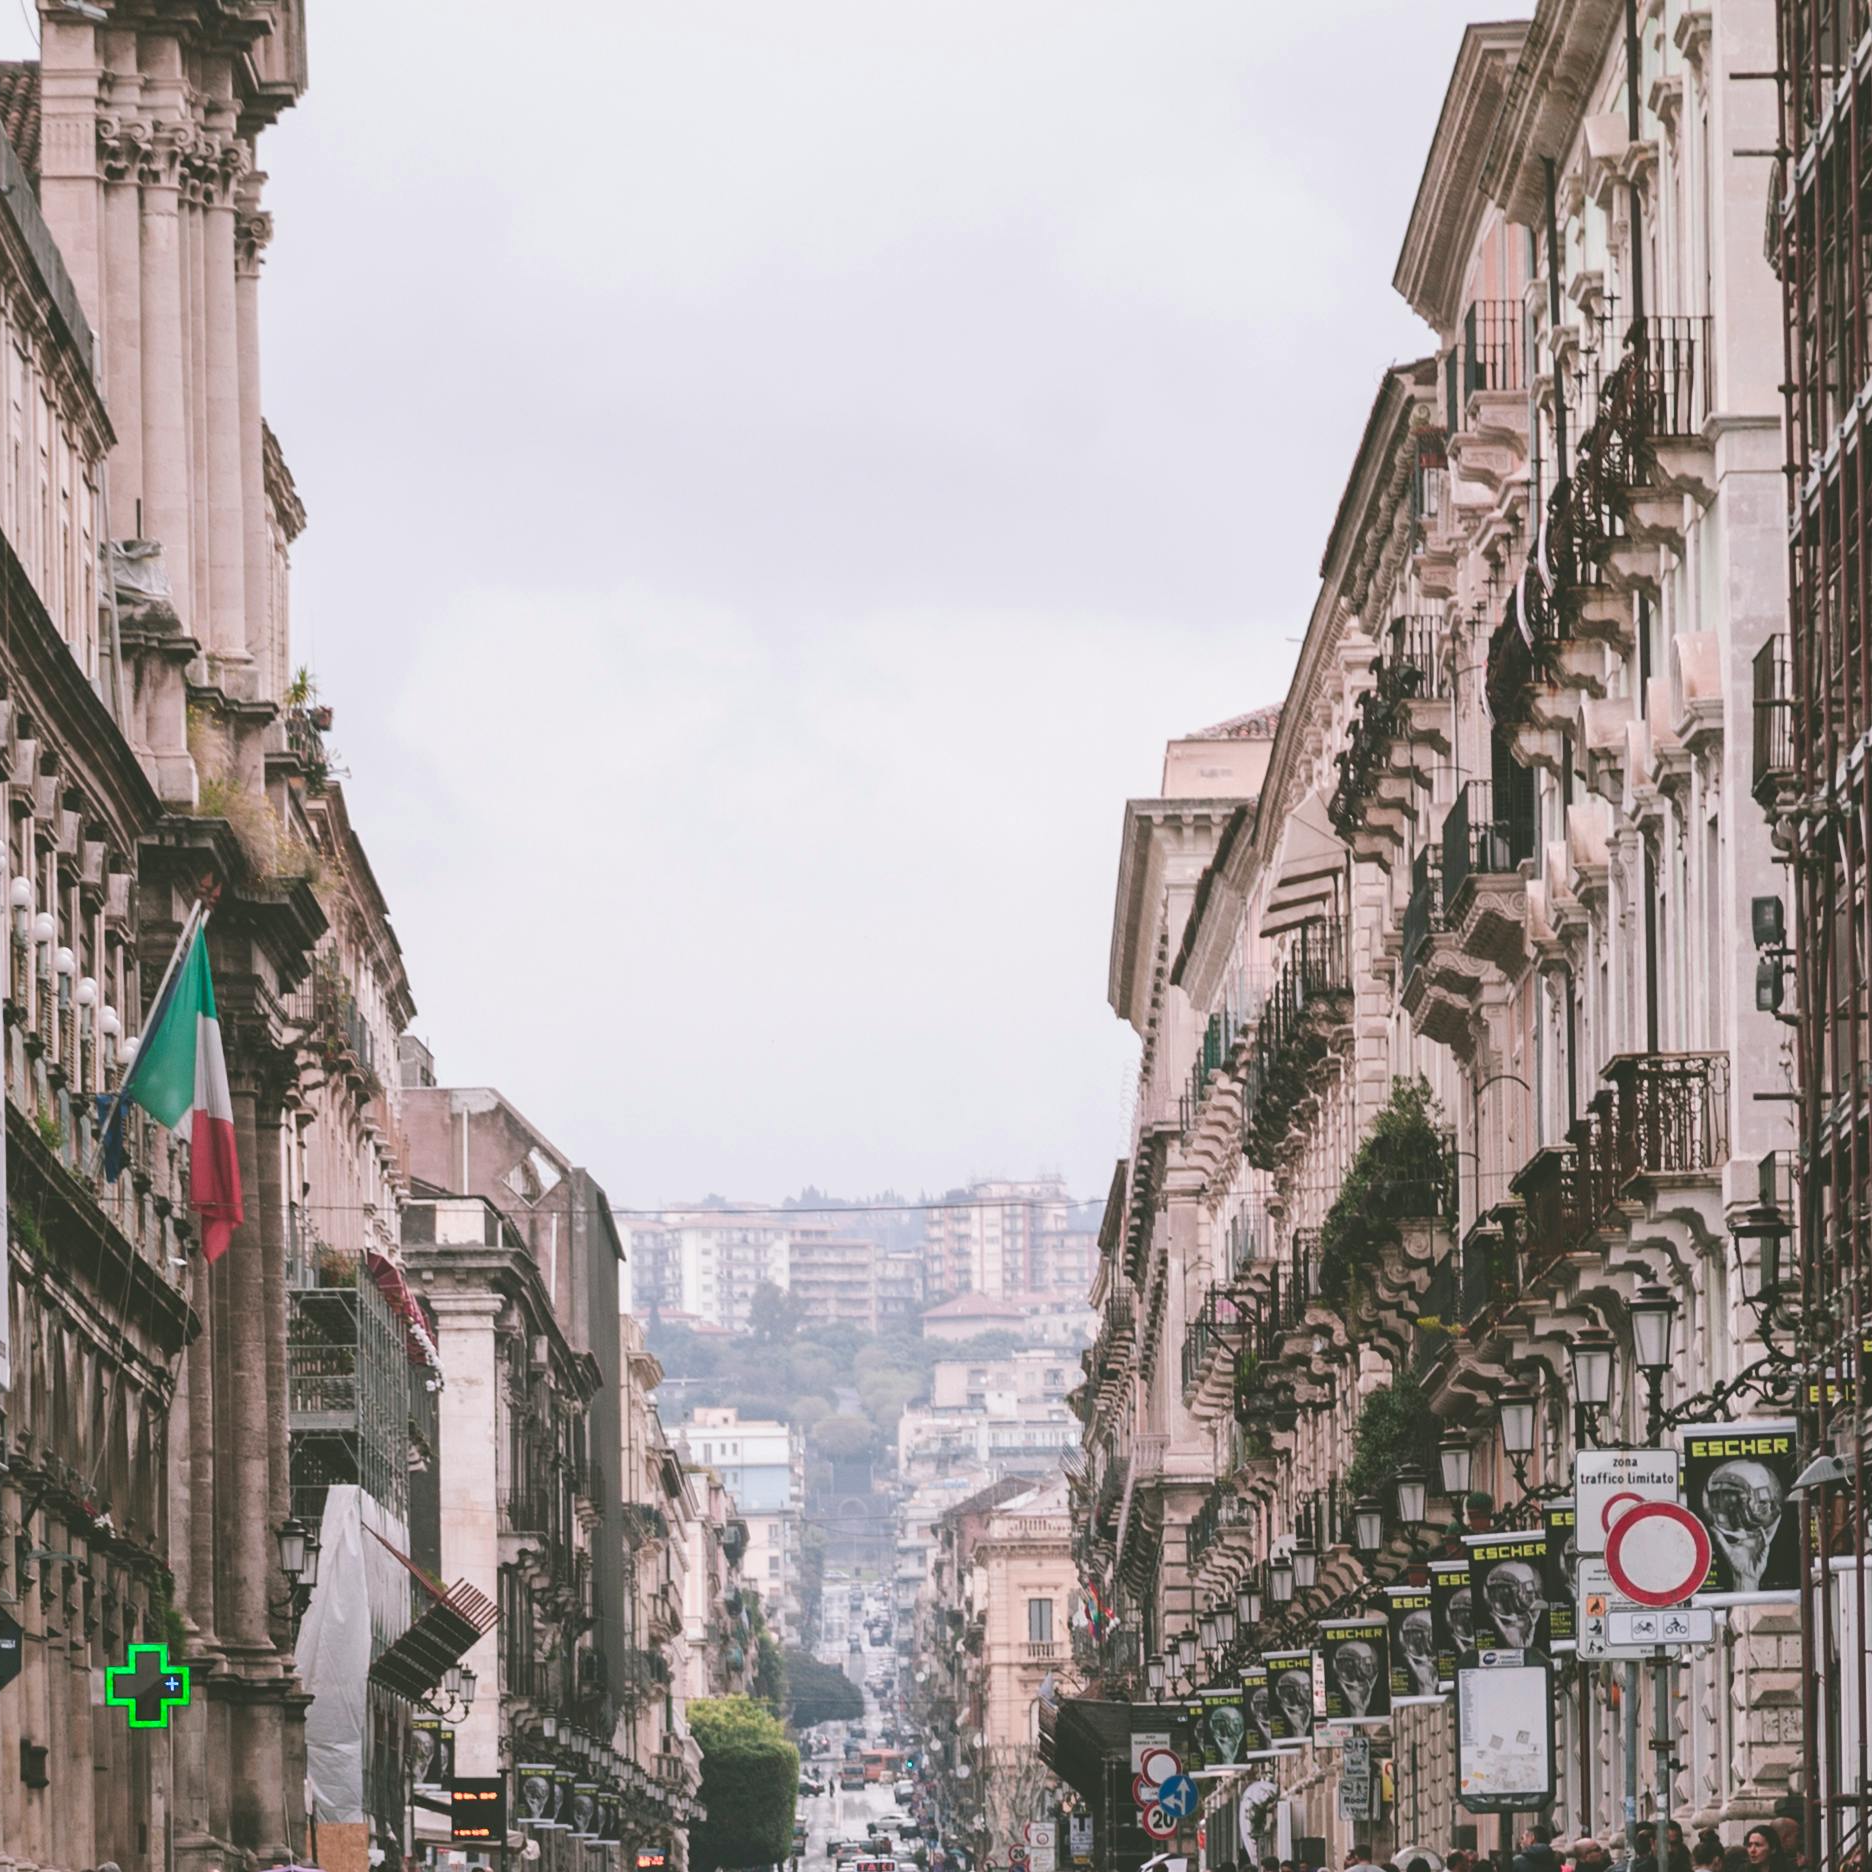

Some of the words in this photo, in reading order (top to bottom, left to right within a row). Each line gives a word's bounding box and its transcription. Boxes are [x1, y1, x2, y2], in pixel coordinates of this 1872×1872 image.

[1691, 1438, 1789, 1457] ESCHER
[1613, 1457, 1638, 1467] zona
[1580, 1472, 1624, 1485] traffico
[1628, 1471, 1674, 1485] limitato
[1473, 1543, 1547, 1561] ESCHER
[1326, 1628, 1383, 1640] ESCHER
[1152, 1810, 1175, 1829] 20
[1013, 1849, 1025, 1859] 20
